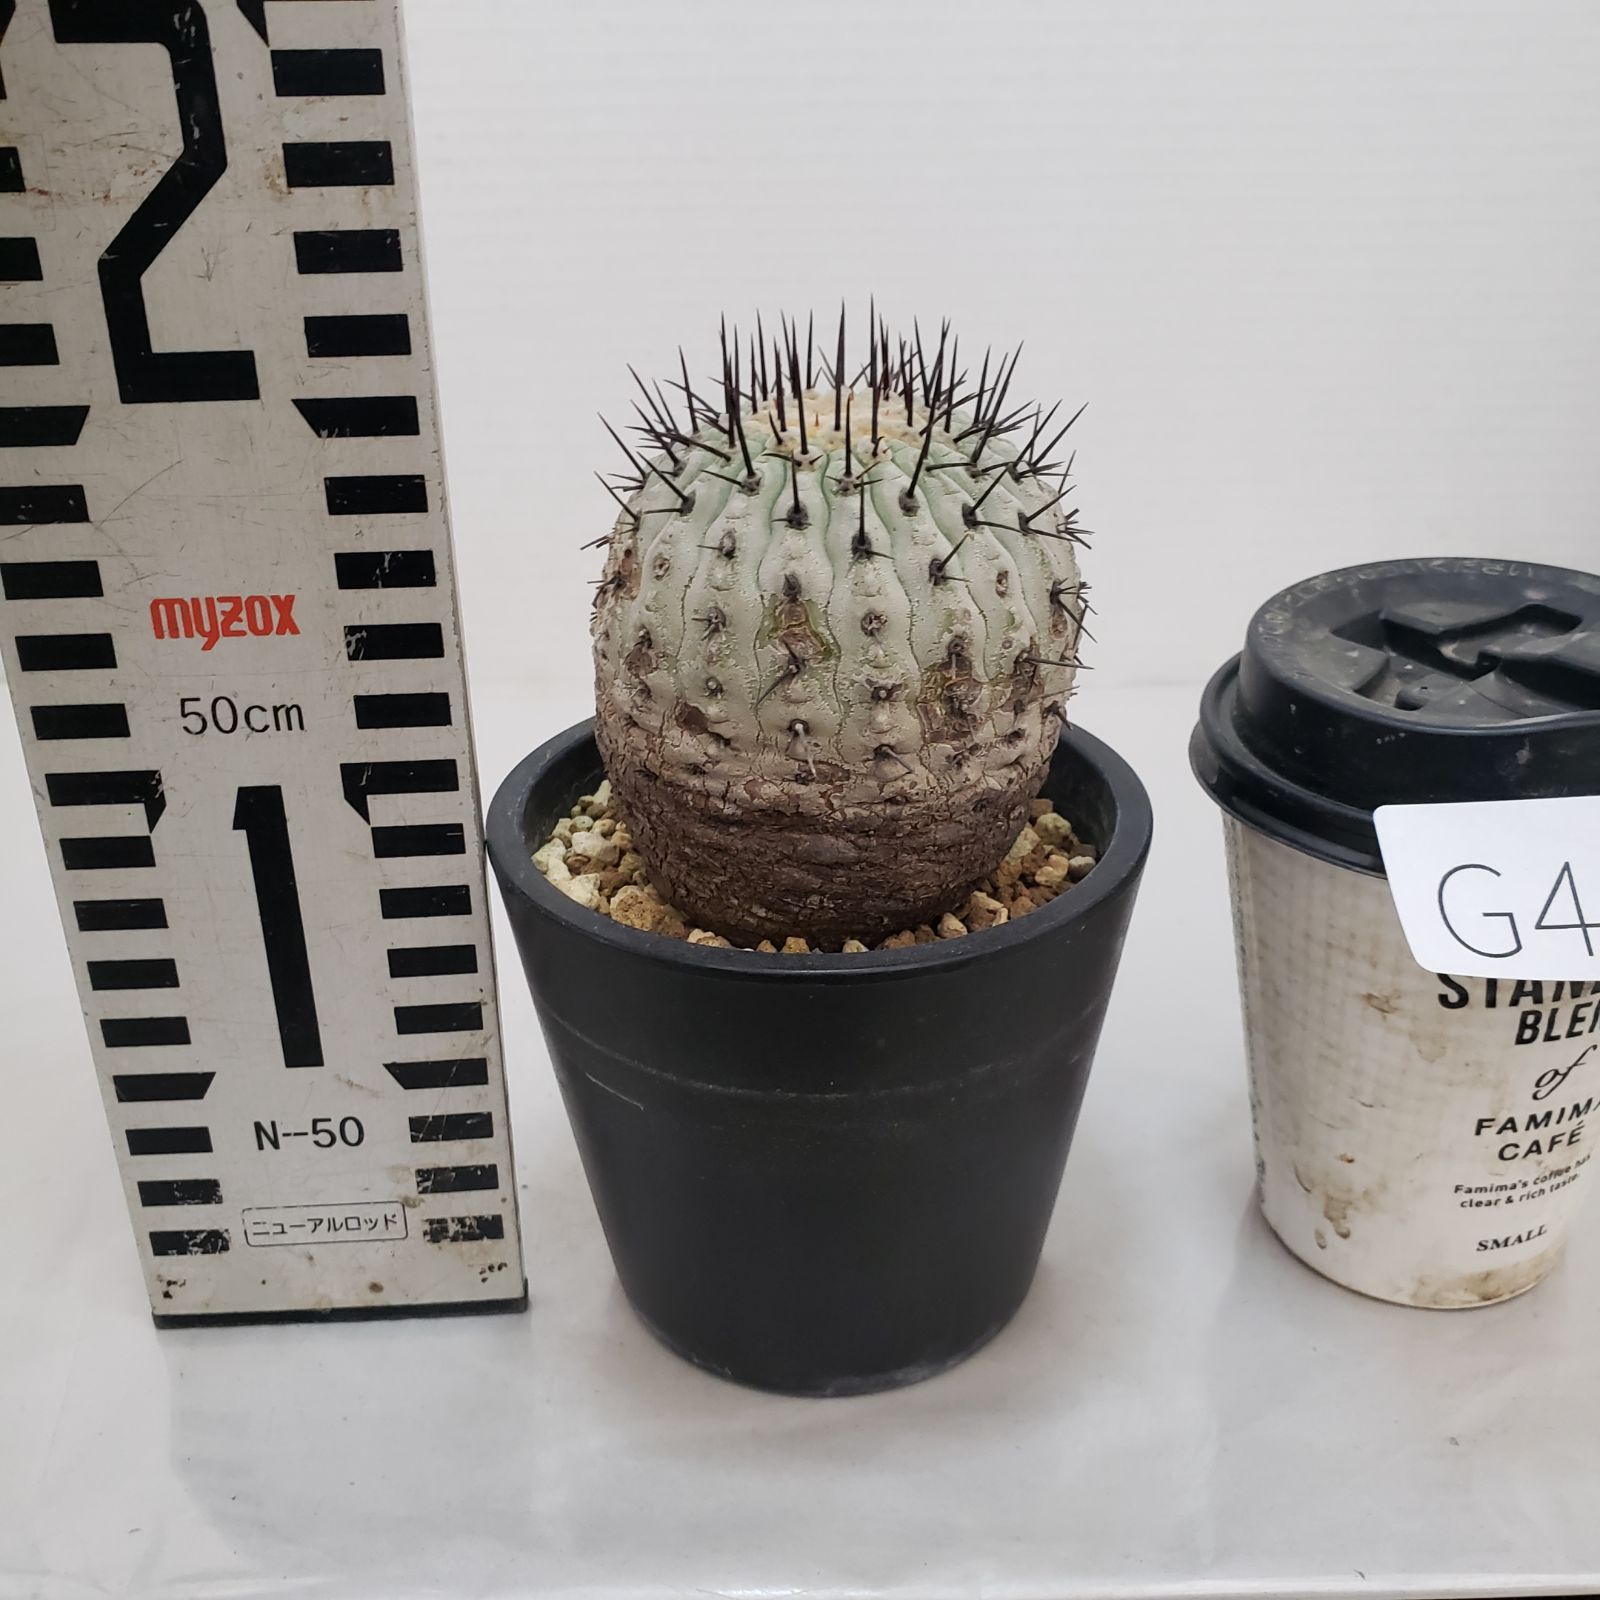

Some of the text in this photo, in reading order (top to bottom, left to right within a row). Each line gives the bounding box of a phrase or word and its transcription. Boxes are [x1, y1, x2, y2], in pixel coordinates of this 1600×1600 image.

[48, 0, 260, 404] 2
[179, 695, 305, 736] 50cm
[232, 785, 325, 1069] 1
[1438, 861, 1600, 958] G4
[1437, 972, 1600, 1010] STAN
[1532, 1044, 1598, 1101] of
[1498, 1120, 1585, 1161] CAFÉ
[1453, 1179, 1529, 1195] Famima's
[1533, 1165, 1572, 1186] coffee
[1460, 1197, 1502, 1208] clear
[1519, 1187, 1546, 1202] rich
[252, 1213, 398, 1236] ニューアルロッド
[1476, 1223, 1549, 1252] SMALL
